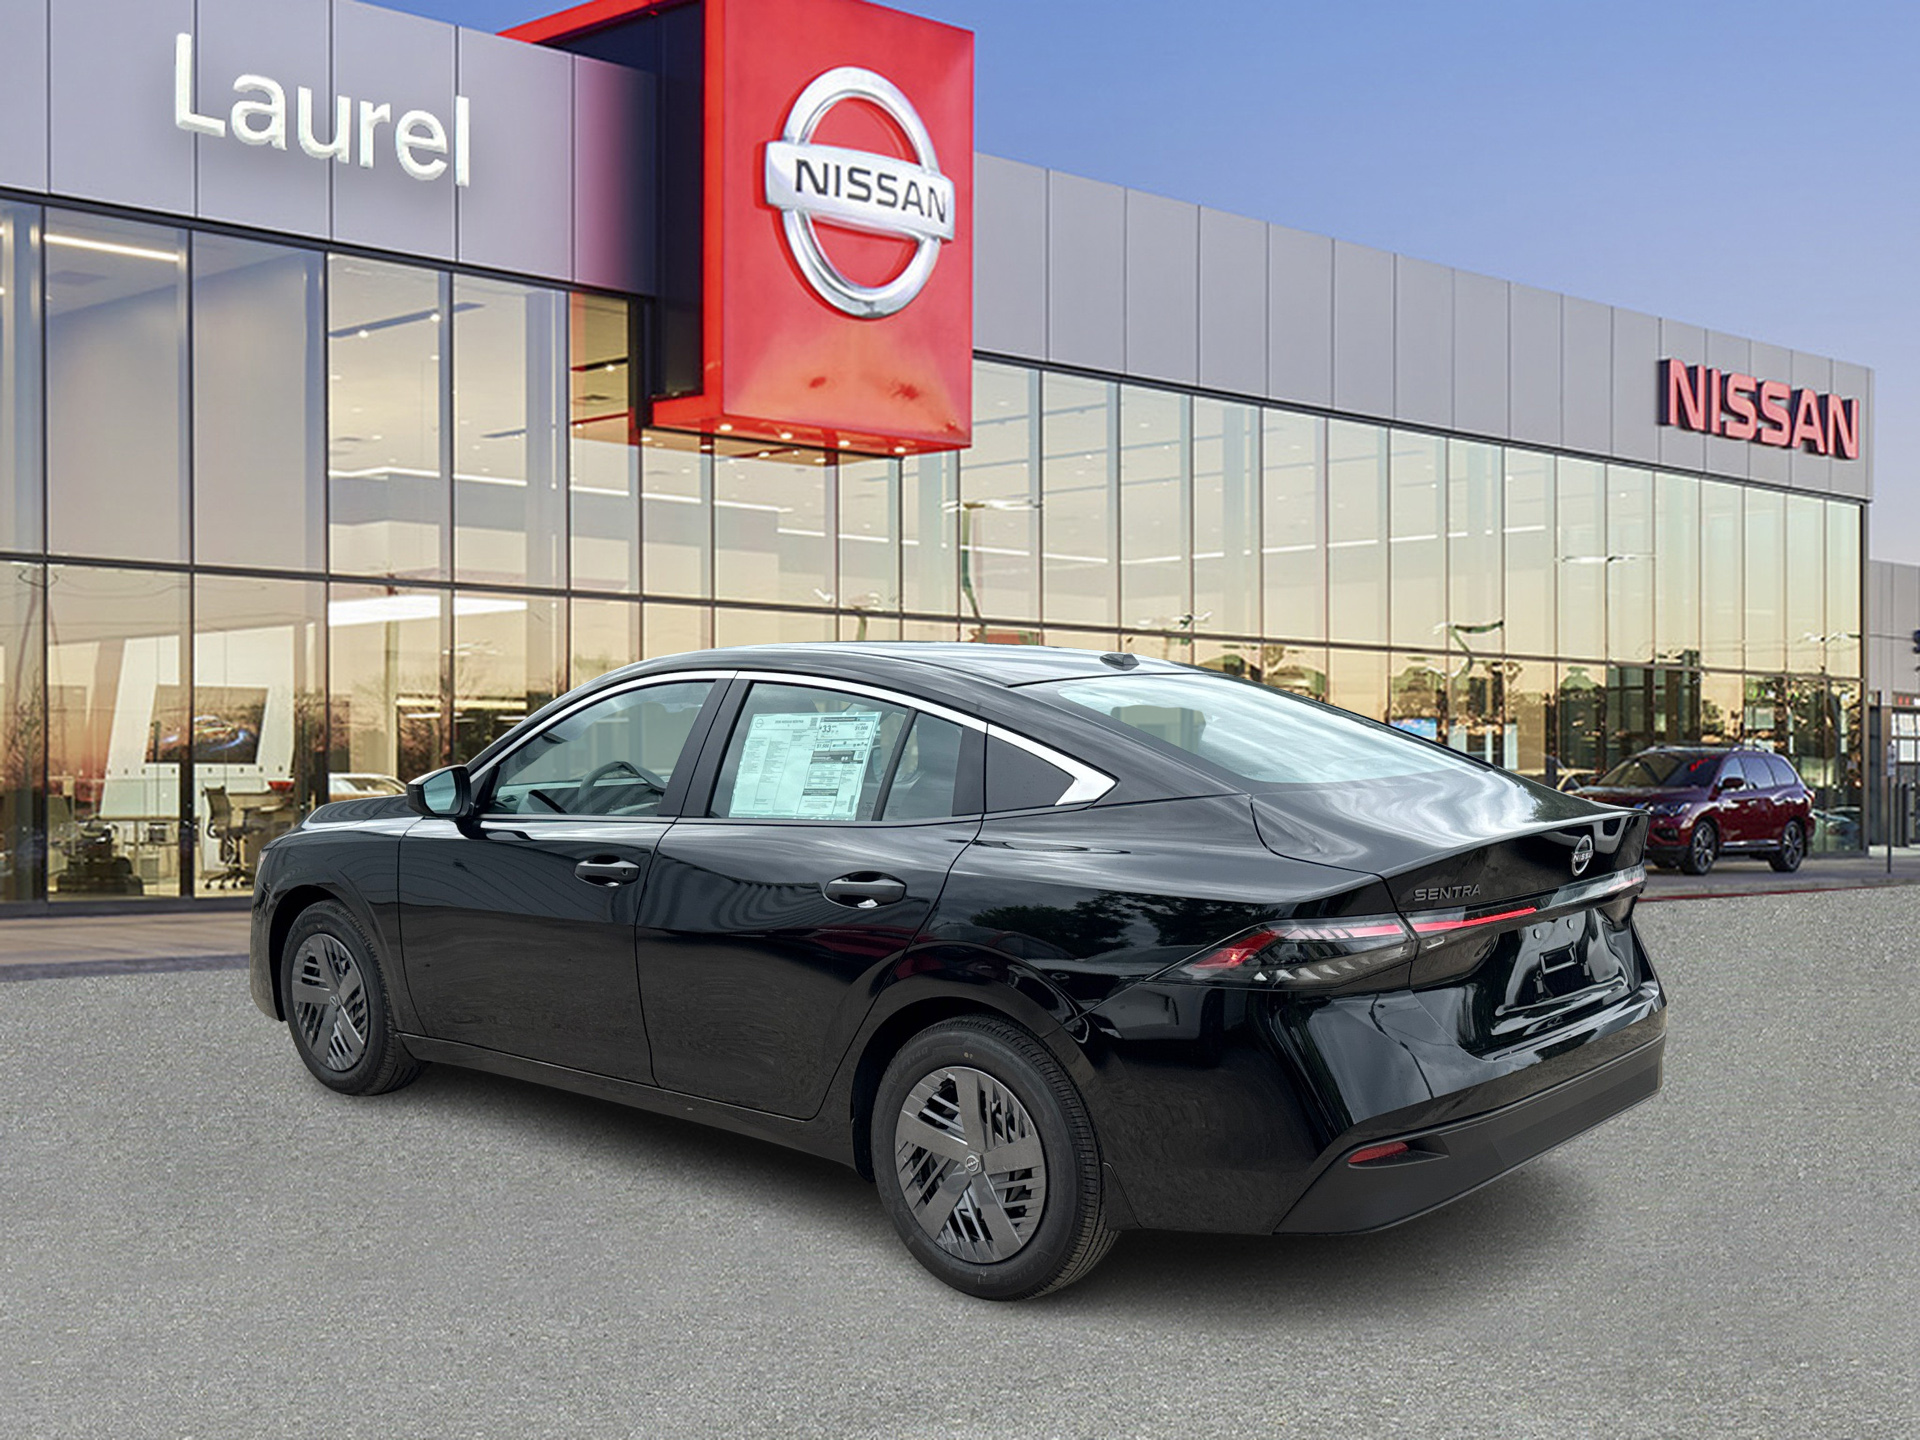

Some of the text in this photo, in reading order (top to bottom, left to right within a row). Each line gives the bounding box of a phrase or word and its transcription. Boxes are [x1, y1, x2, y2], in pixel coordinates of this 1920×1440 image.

[175, 32, 470, 188] Laurel
[795, 158, 946, 224] NISSAN
[1659, 357, 1860, 461] NISSAN
[1413, 884, 1481, 902] SENTRA
